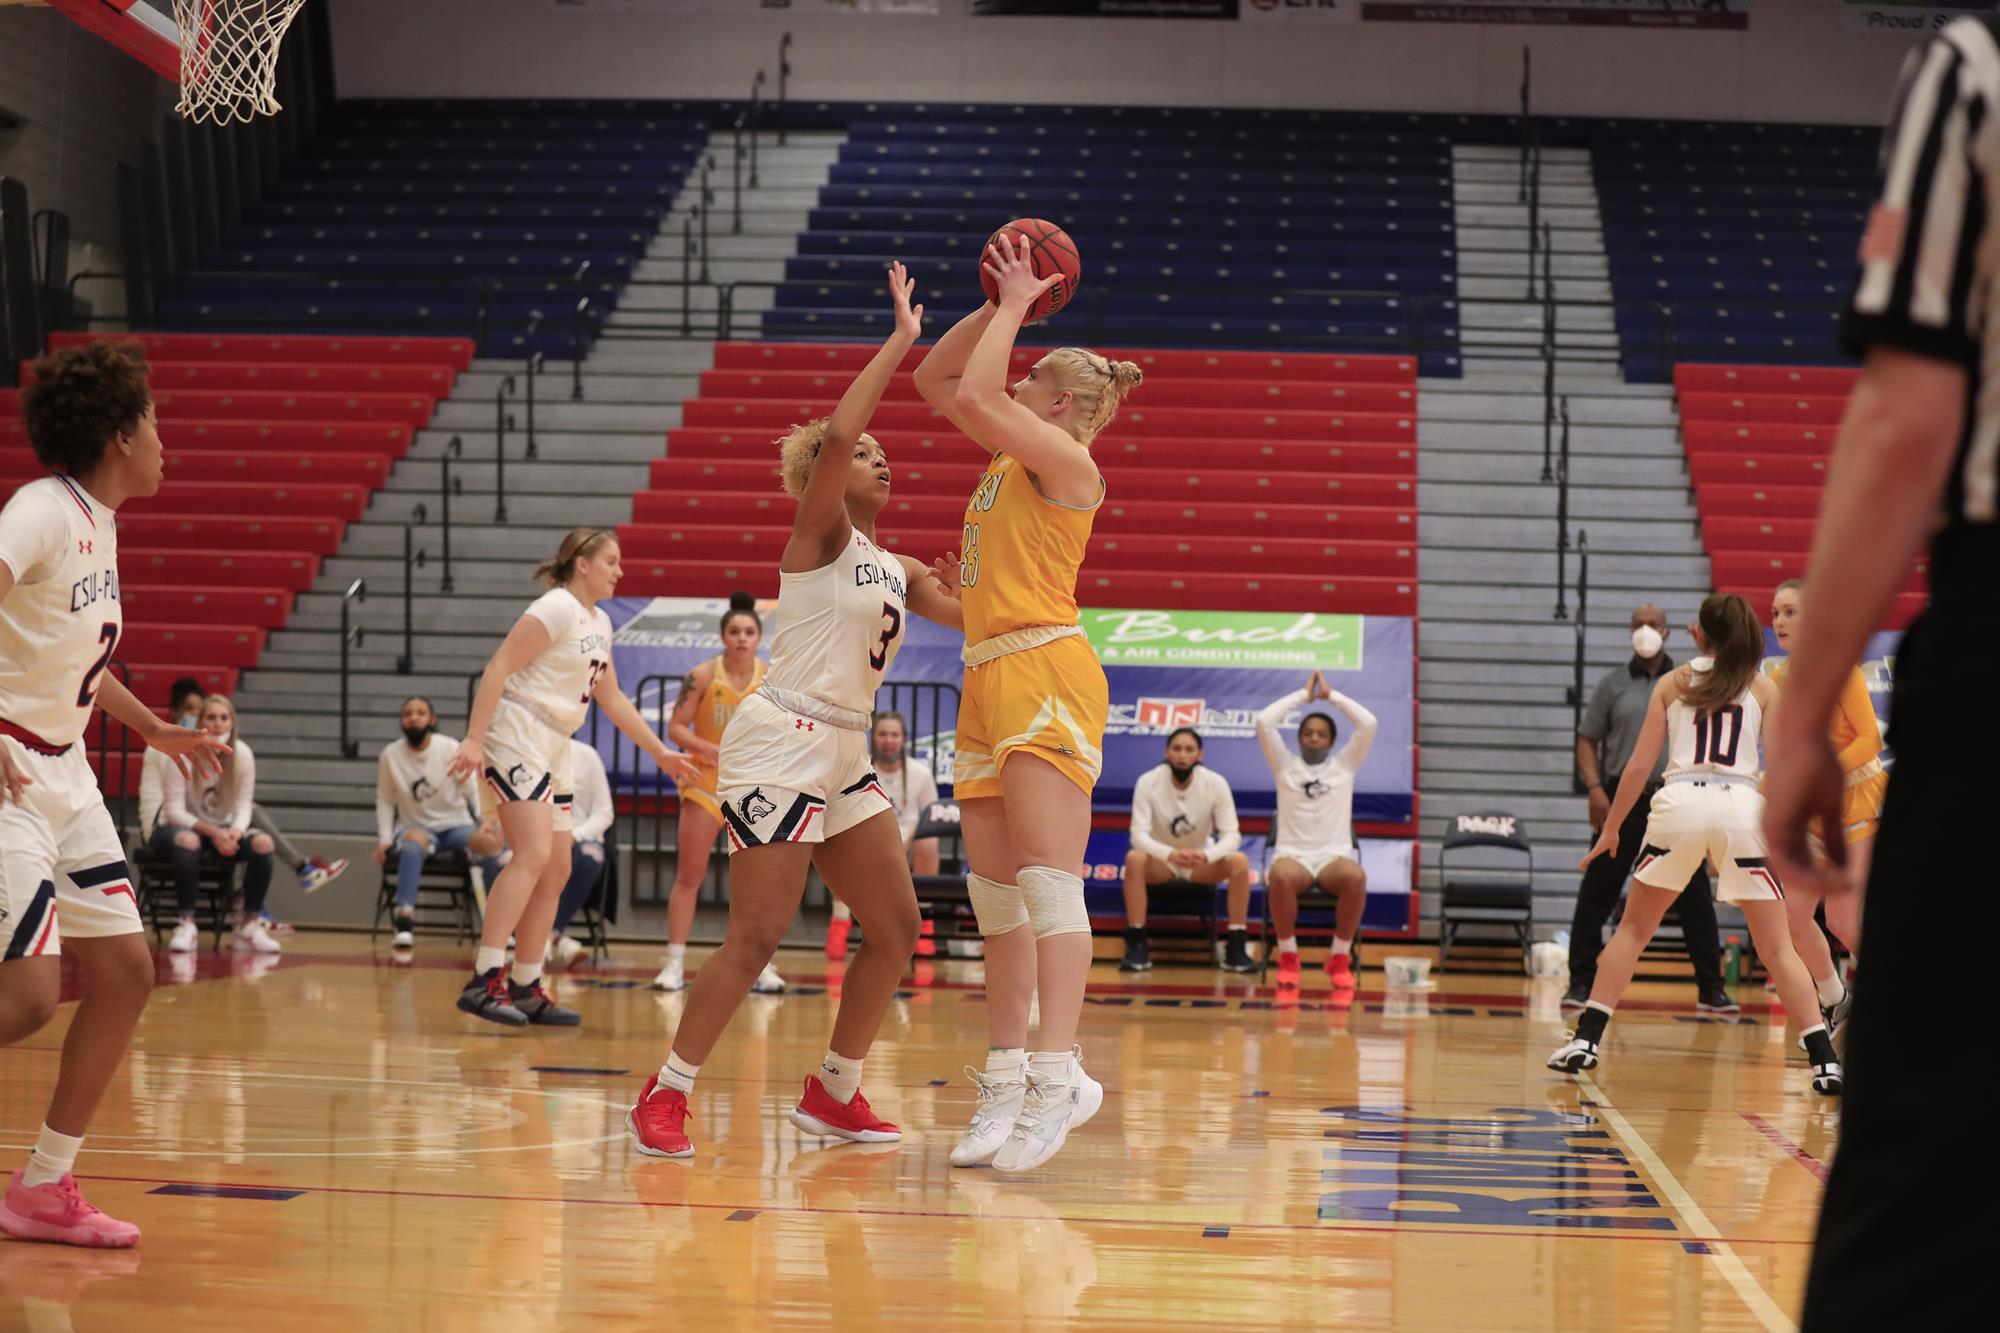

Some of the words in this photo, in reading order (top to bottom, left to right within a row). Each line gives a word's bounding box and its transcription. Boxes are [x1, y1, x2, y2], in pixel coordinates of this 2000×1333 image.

[70, 569, 120, 612] CSU-PU
[869, 600, 900, 672] 3
[1097, 611, 1342, 643] Buck
[1124, 647, 1159, 659] AIR
[1167, 648, 1316, 662] CONDITIONING
[76, 622, 118, 708] 2
[1693, 703, 1743, 767] 10
[1317, 1104, 1681, 1231] RMAC
